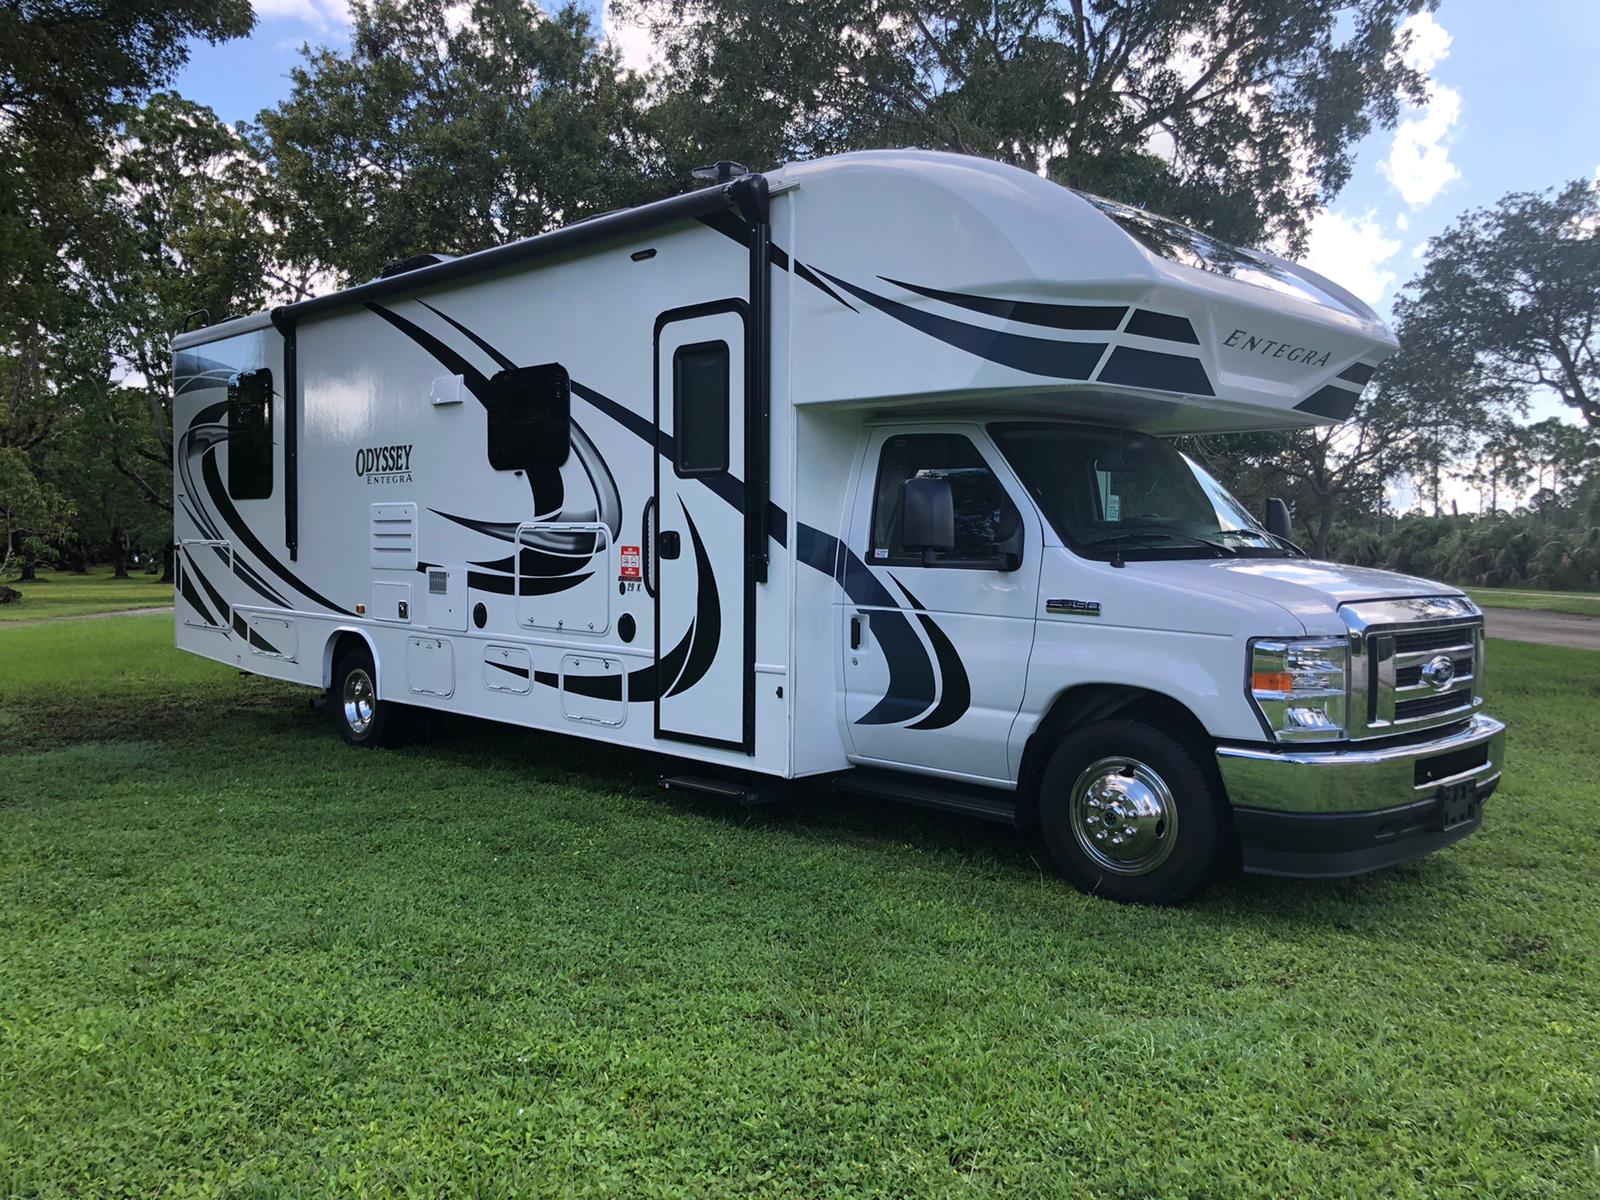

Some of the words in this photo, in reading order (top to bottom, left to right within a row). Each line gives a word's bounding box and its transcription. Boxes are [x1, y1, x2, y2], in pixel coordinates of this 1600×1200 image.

[1222, 329, 1331, 367] ENTEGRA
[356, 444, 412, 477] ODYSSEY
[367, 473, 413, 485] ENTEGRA
